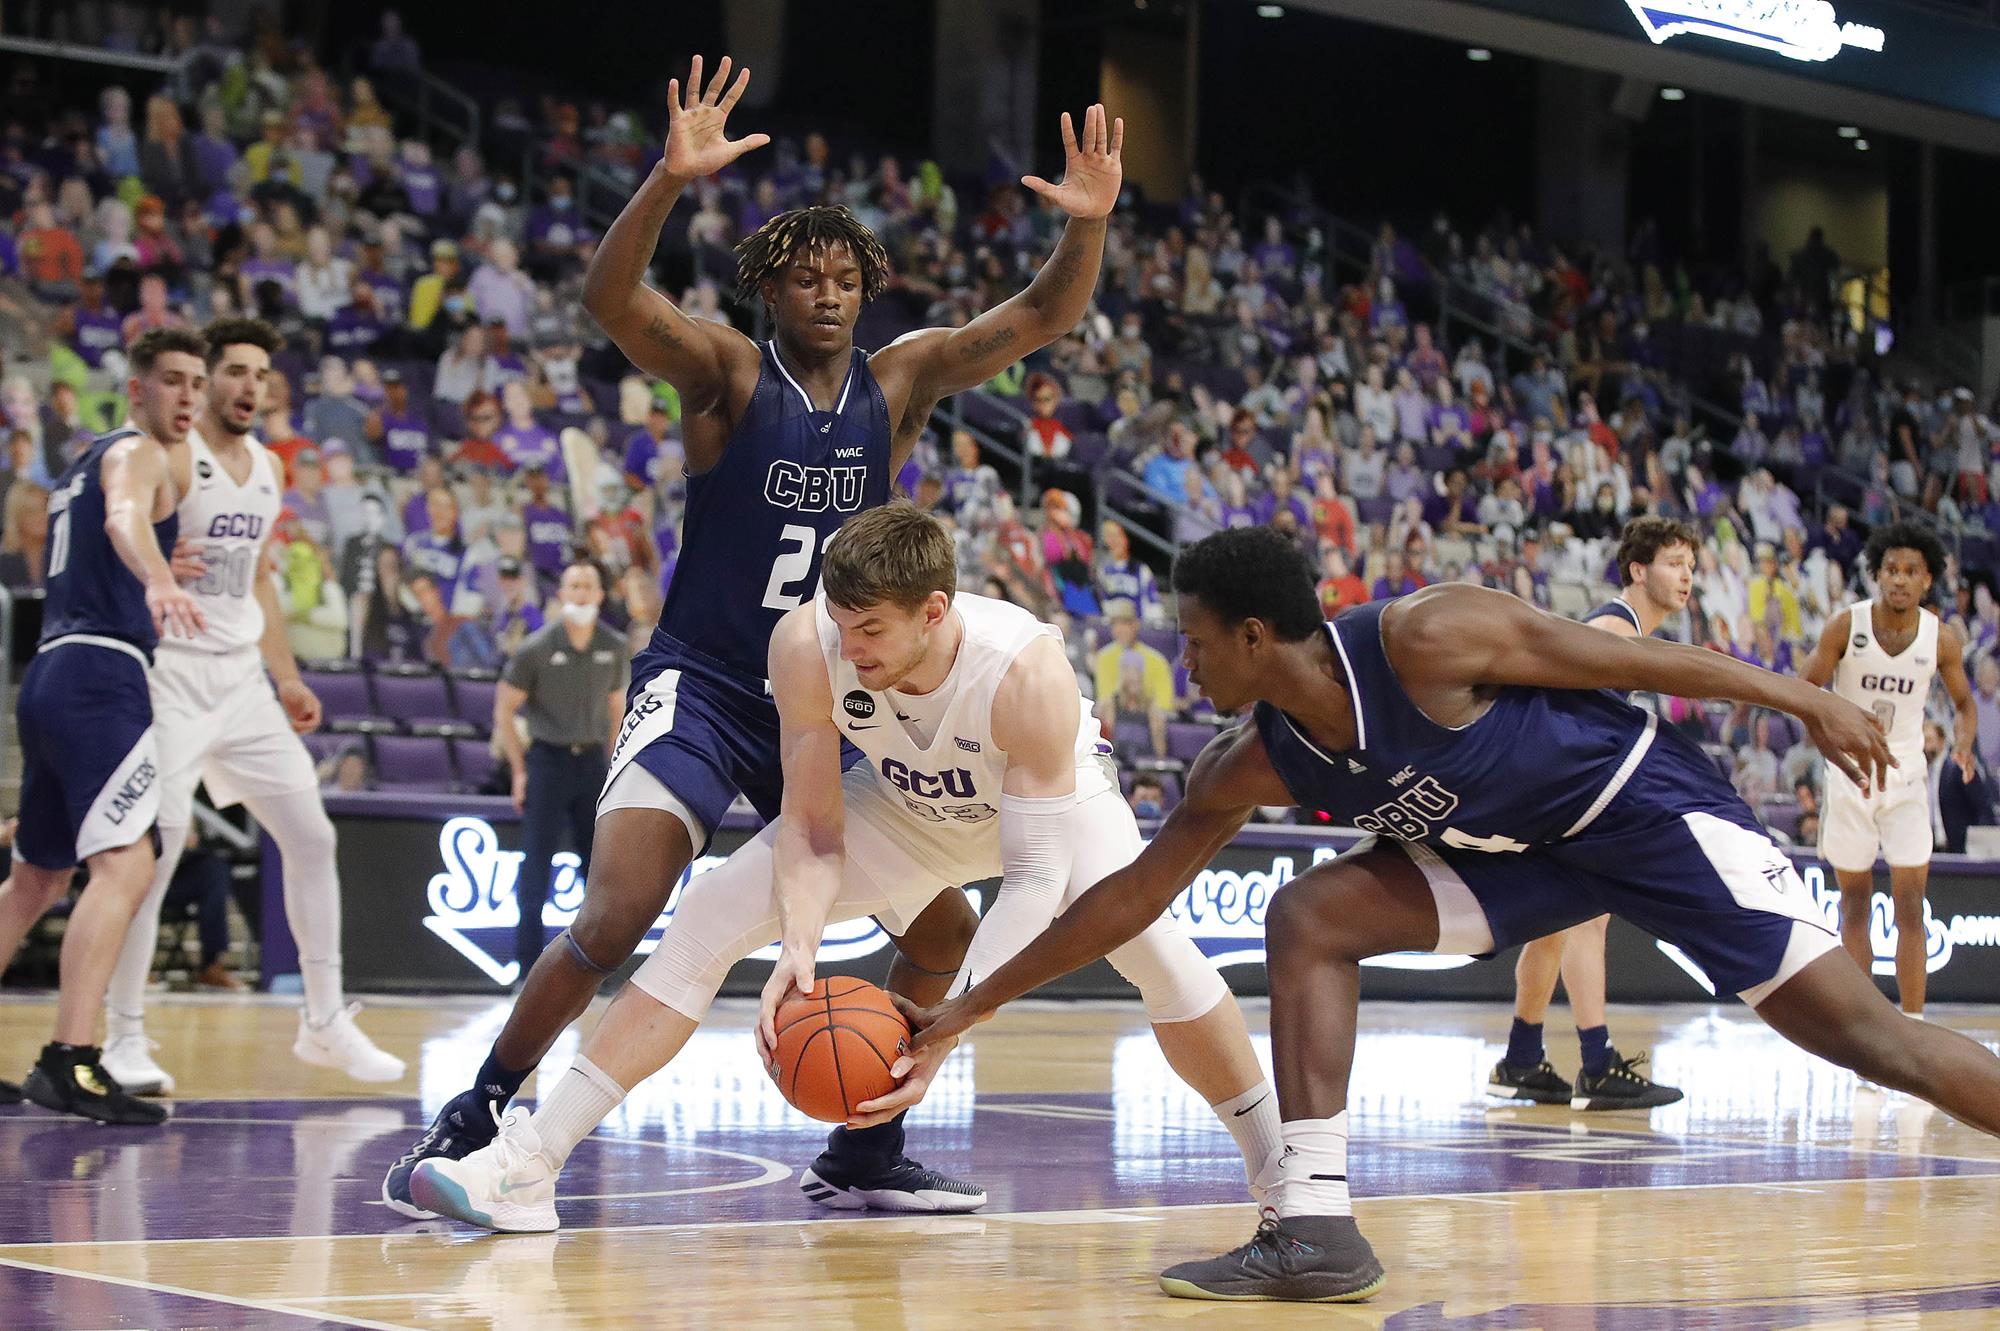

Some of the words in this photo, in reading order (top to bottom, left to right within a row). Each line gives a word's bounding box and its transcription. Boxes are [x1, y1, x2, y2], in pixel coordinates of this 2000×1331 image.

[835, 447, 864, 459] WAC
[764, 459, 867, 513] CBU
[207, 512, 263, 540] GCU
[761, 524, 842, 611] 2
[1861, 674, 1914, 695] GCU
[955, 736, 981, 752] WAC
[103, 757, 157, 825] LANCERS
[882, 757, 977, 799] GCU
[1387, 764, 1417, 787] WAC
[1353, 776, 1459, 841] CBU
